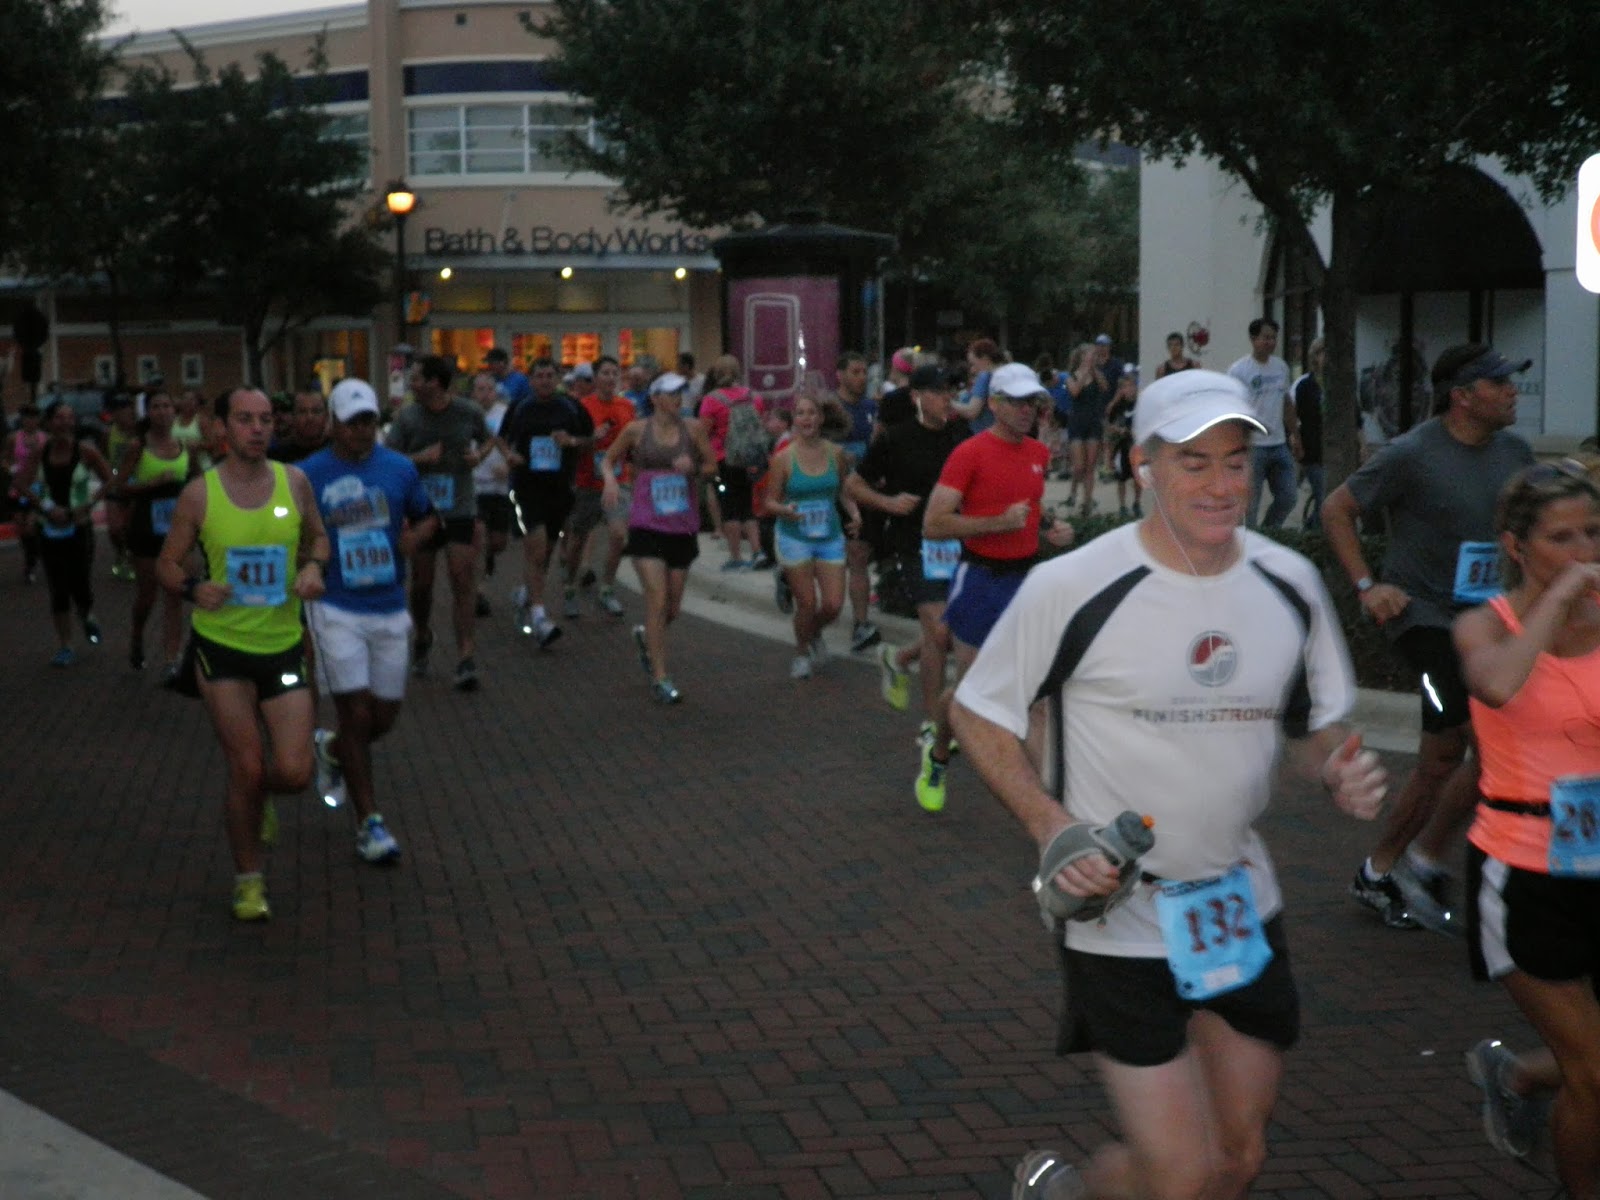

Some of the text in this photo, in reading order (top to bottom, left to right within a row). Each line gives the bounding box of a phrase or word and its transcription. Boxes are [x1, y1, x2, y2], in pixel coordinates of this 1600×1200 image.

[425, 227, 496, 251] Bath
[502, 227, 524, 251] &
[236, 561, 277, 587] 411
[1184, 893, 1254, 954] 132
